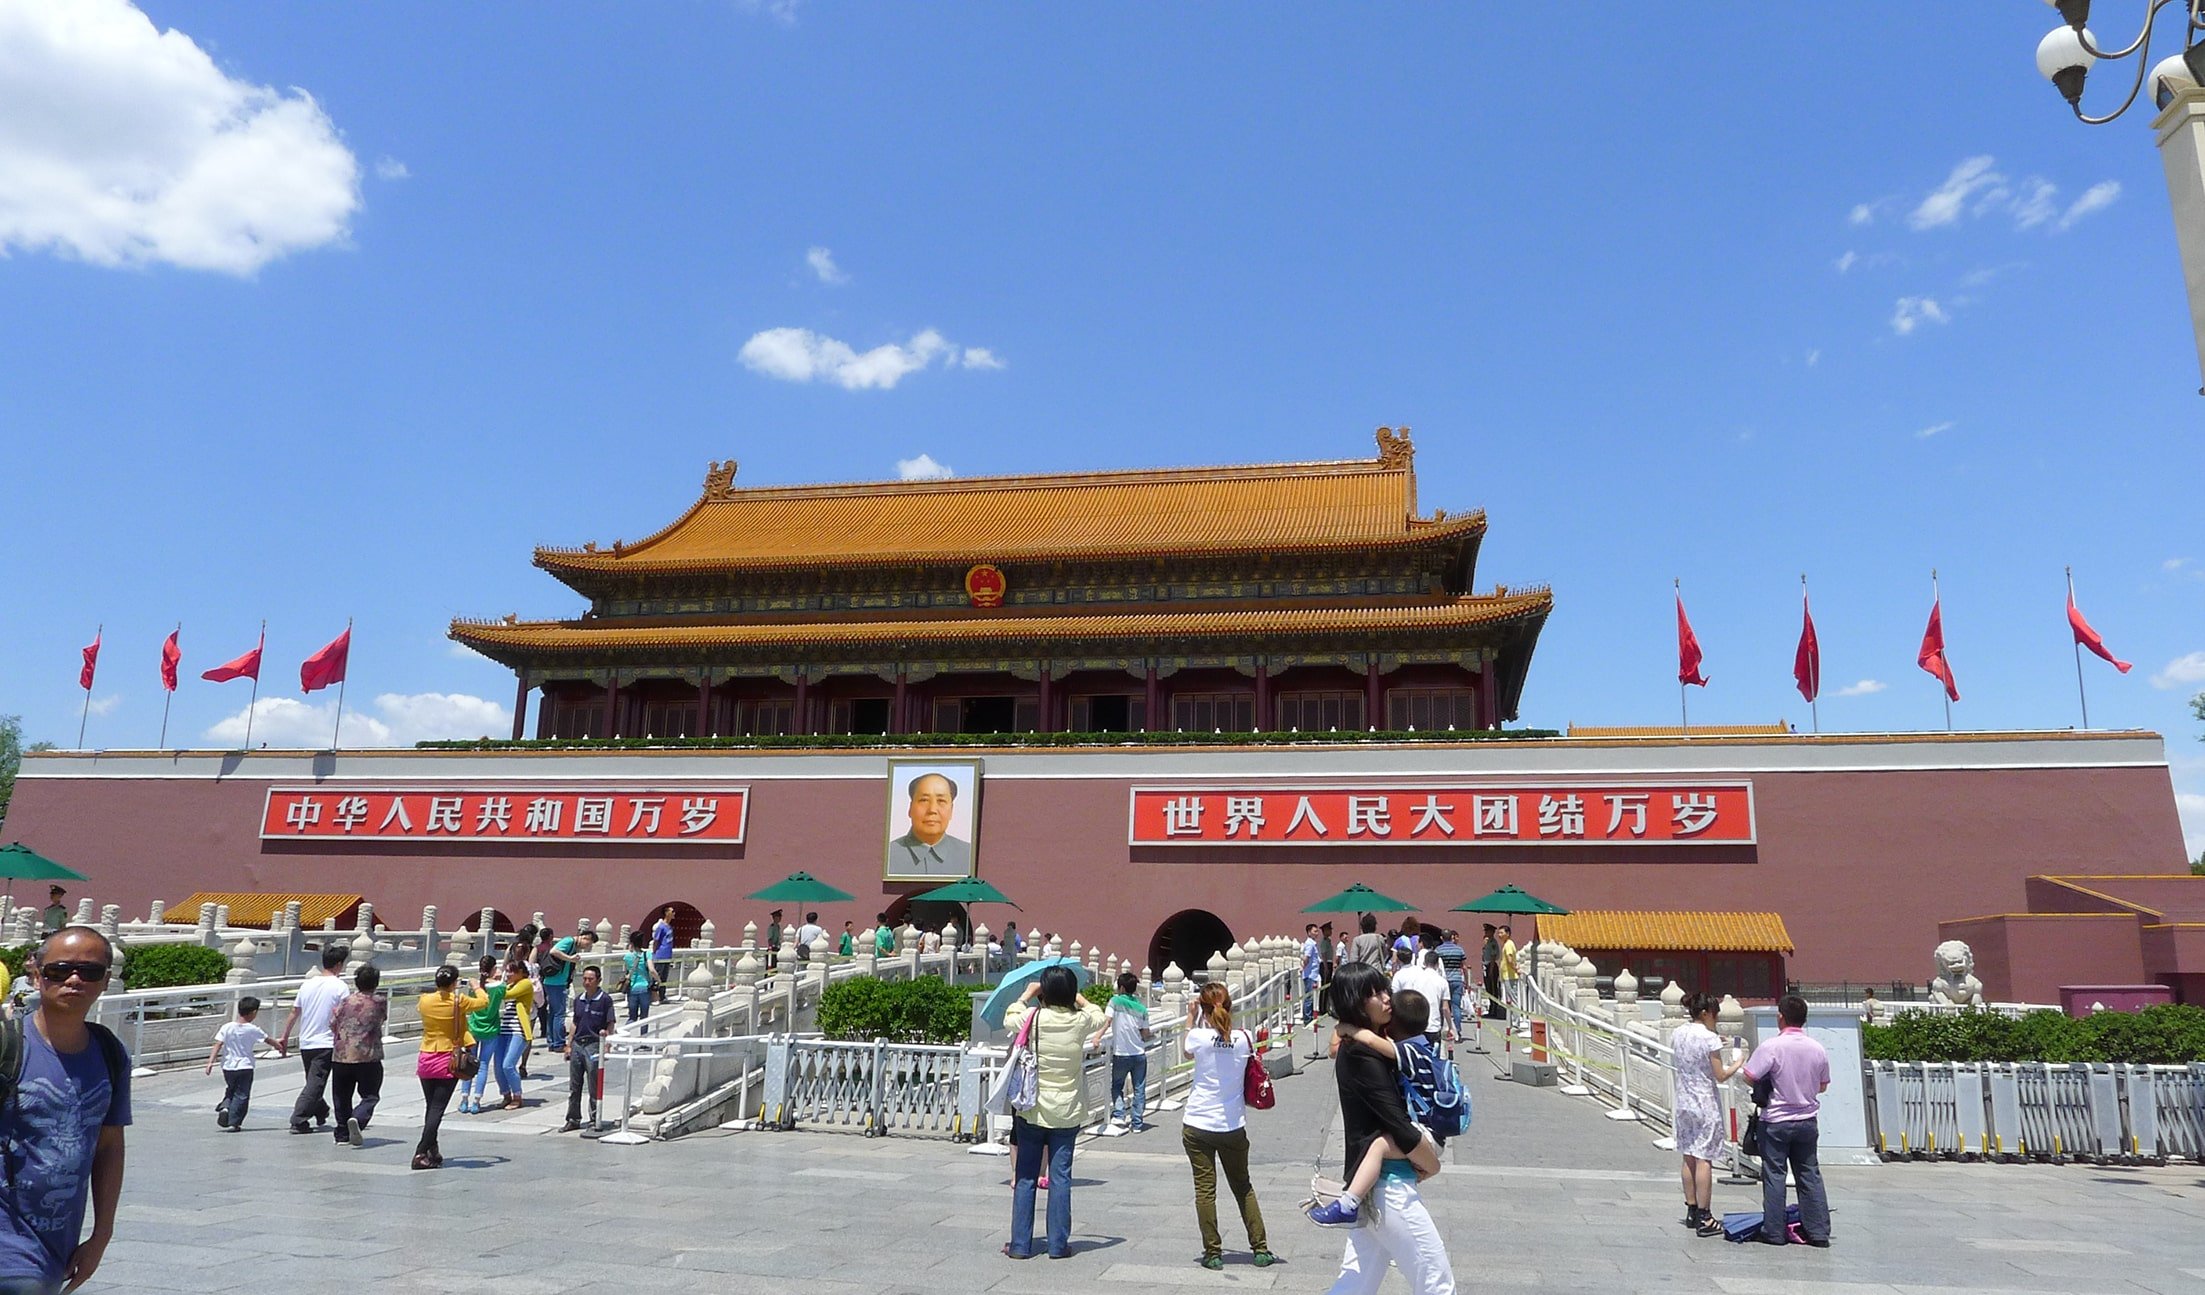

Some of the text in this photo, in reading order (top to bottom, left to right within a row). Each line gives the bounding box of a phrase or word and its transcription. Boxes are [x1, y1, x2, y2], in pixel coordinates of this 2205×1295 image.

[286, 796, 718, 833] 中华人民共和国万岁
[1162, 793, 1718, 836] 世界人民大团结万岁
